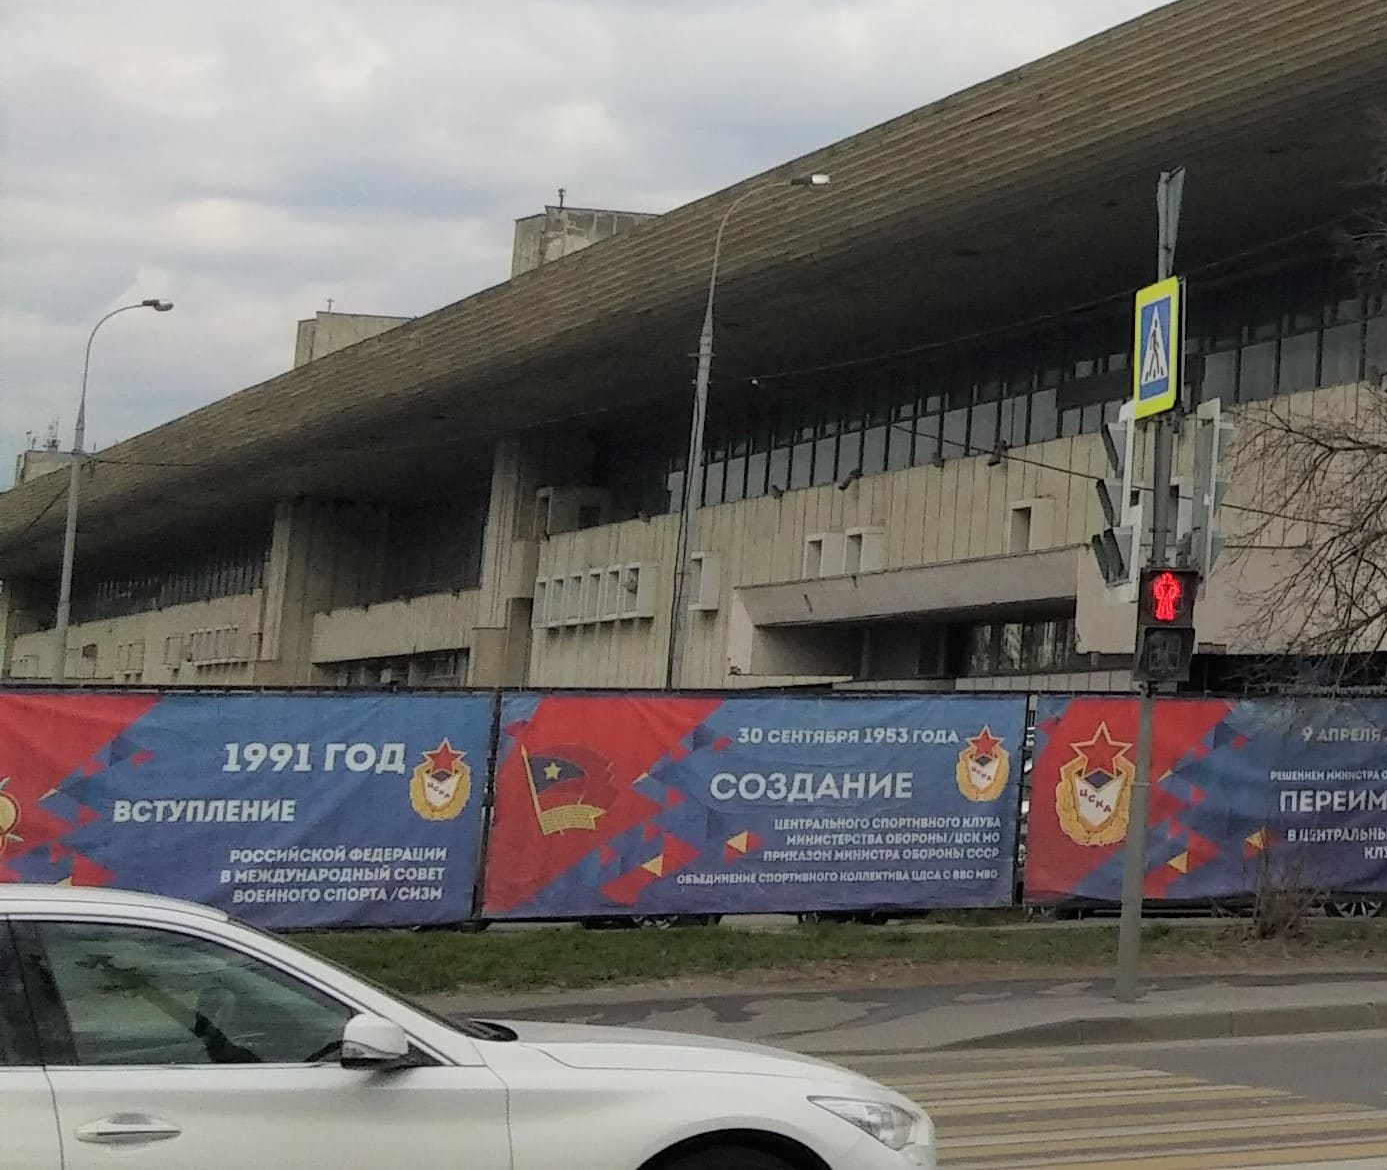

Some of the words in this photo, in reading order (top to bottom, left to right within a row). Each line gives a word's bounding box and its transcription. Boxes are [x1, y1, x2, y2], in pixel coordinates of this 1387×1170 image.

[737, 727, 762, 745] 30
[767, 728, 860, 745] СЕНТЯБРЯ
[863, 727, 909, 744] 1953
[912, 728, 961, 745] ГОДА
[1302, 726, 1313, 742] 9
[1316, 727, 1380, 742] АПРЕЛЯ
[222, 742, 312, 773] 1991
[323, 742, 406, 775] ГОД
[709, 772, 914, 803] СОЗДАНИЕ
[1079, 788, 1112, 813] ЦСКА
[112, 799, 297, 823] ВСТУПЛЕНИЕ
[773, 818, 871, 831] ЦЕНТРАЛЬНОГО
[872, 816, 961, 830] СПОРТИВНОГО
[962, 816, 1002, 829] КЛУБА
[786, 833, 884, 846] МИНИСТЕРСТВА
[1287, 828, 1296, 842] В
[229, 844, 347, 863] РОССИЙСКОЙ
[348, 846, 448, 863] ФЕДЕРАЦИИ
[763, 850, 834, 863] ПРИКАЗОМ
[834, 848, 901, 862] МИНИСТРА
[902, 848, 964, 861] ОБОРОНЫ
[966, 847, 1000, 860] СССР
[220, 869, 232, 884] В
[235, 864, 391, 884] МЕЖДУНАРОДНЫЙ
[393, 866, 446, 882] СОВЕТ
[676, 872, 757, 886] ОБЪЕДИНЕНИЕ
[758, 871, 839, 884] СПОРТИВНОГО
[839, 870, 910, 882] КОЛЛЕКТИВА
[232, 888, 321, 904] ВОЕННОГО
[323, 887, 388, 903] СПОРТА
